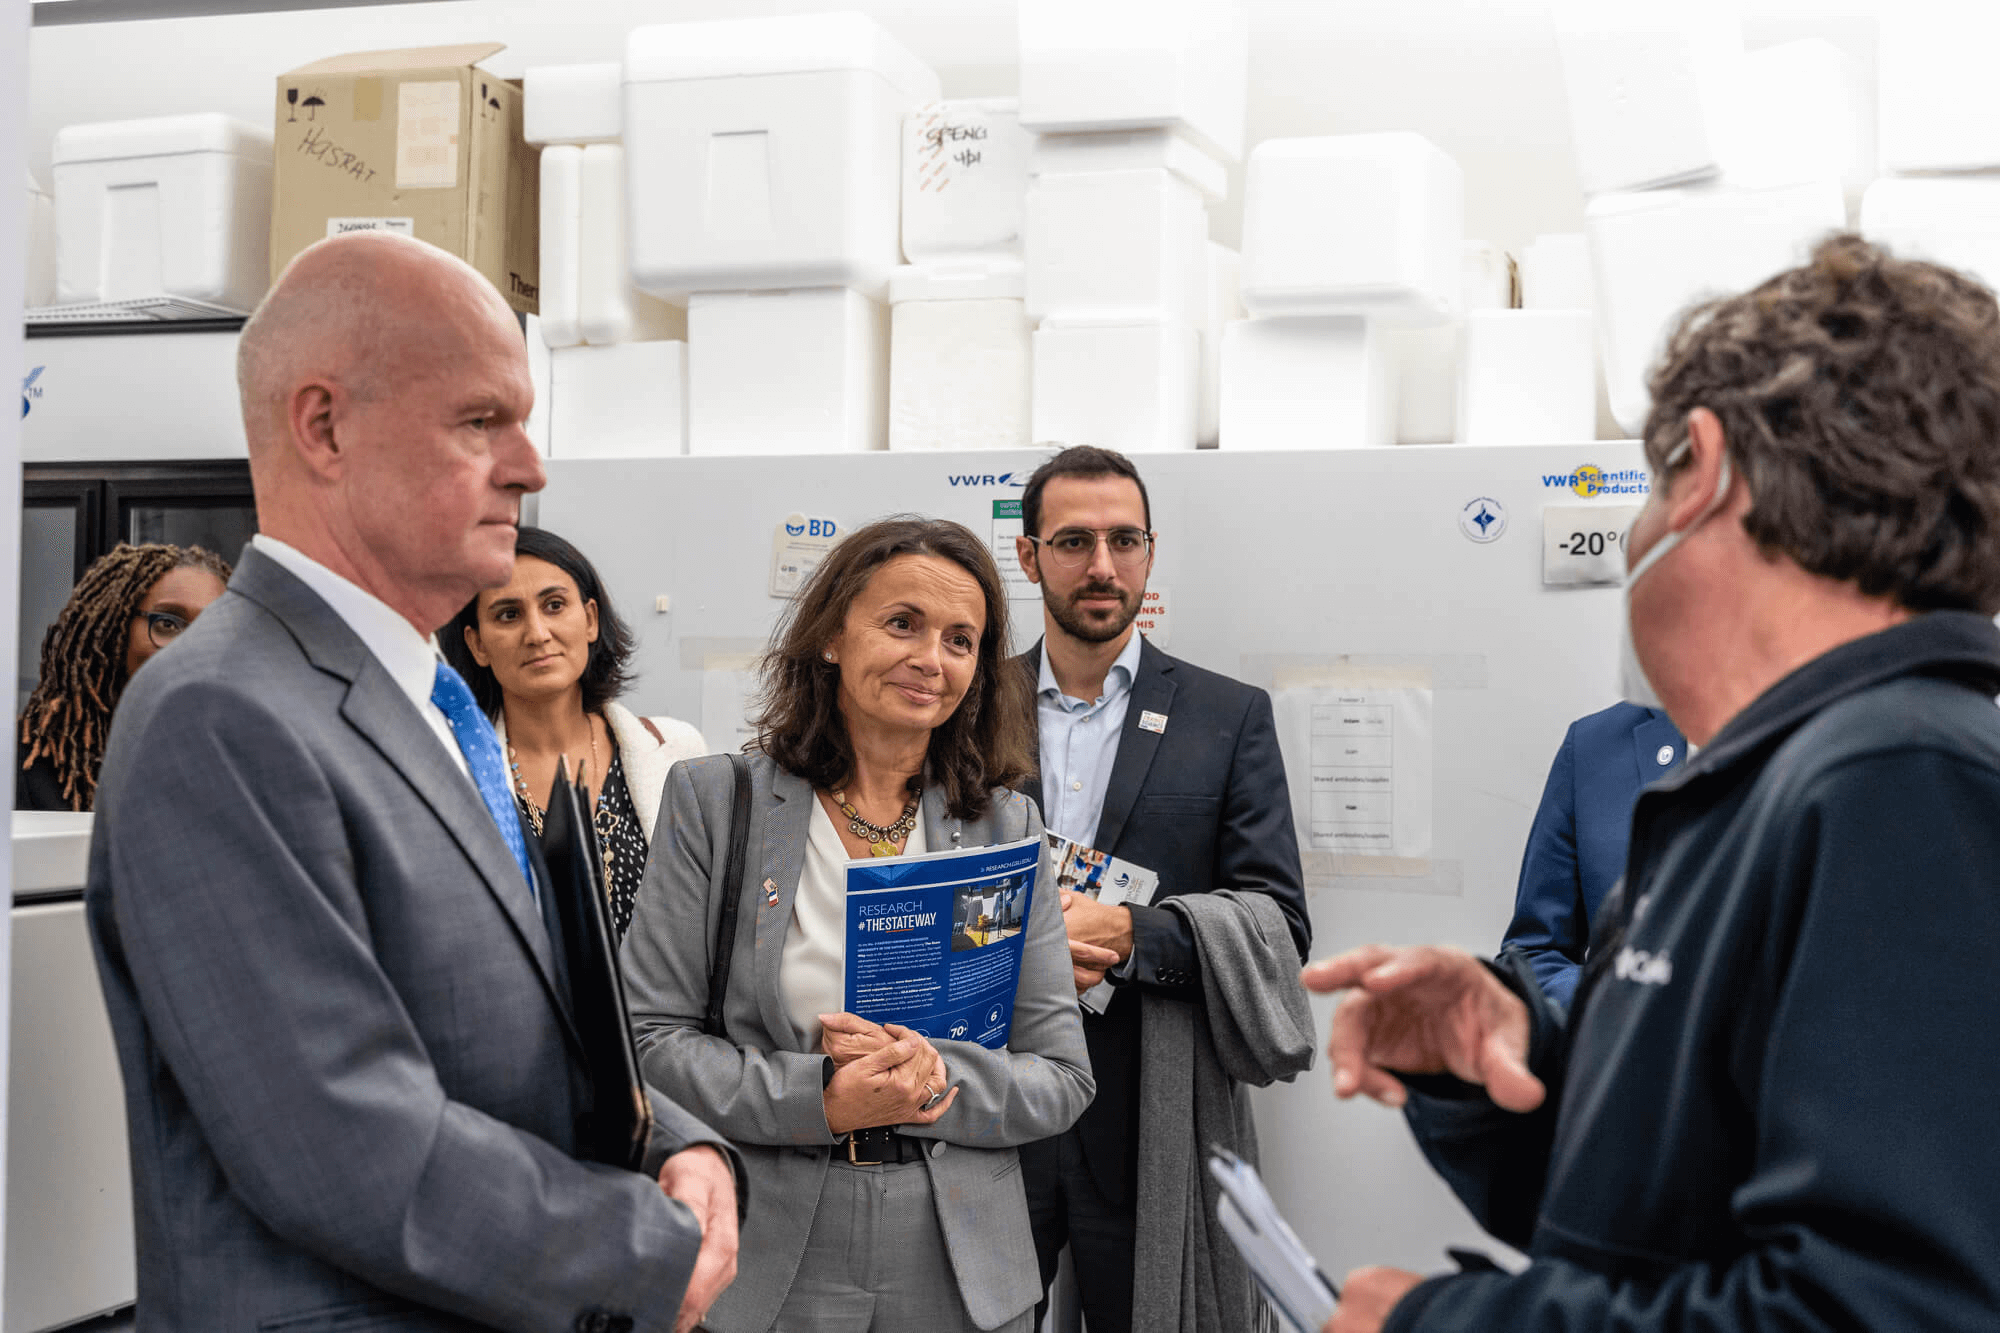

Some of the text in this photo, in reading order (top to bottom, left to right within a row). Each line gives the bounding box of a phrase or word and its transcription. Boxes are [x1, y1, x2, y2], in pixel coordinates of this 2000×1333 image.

[948, 475, 995, 486] VWR
[1542, 470, 1647, 487] VWR Scientific
[1587, 483, 1650, 495] Products
[809, 519, 836, 537] BD
[1143, 592, 1160, 601] OD
[1135, 620, 1155, 629] HIS
[858, 900, 923, 917] RESEARCH
[857, 912, 937, 933] #THESTATEWAY
[990, 1010, 998, 1023] 6
